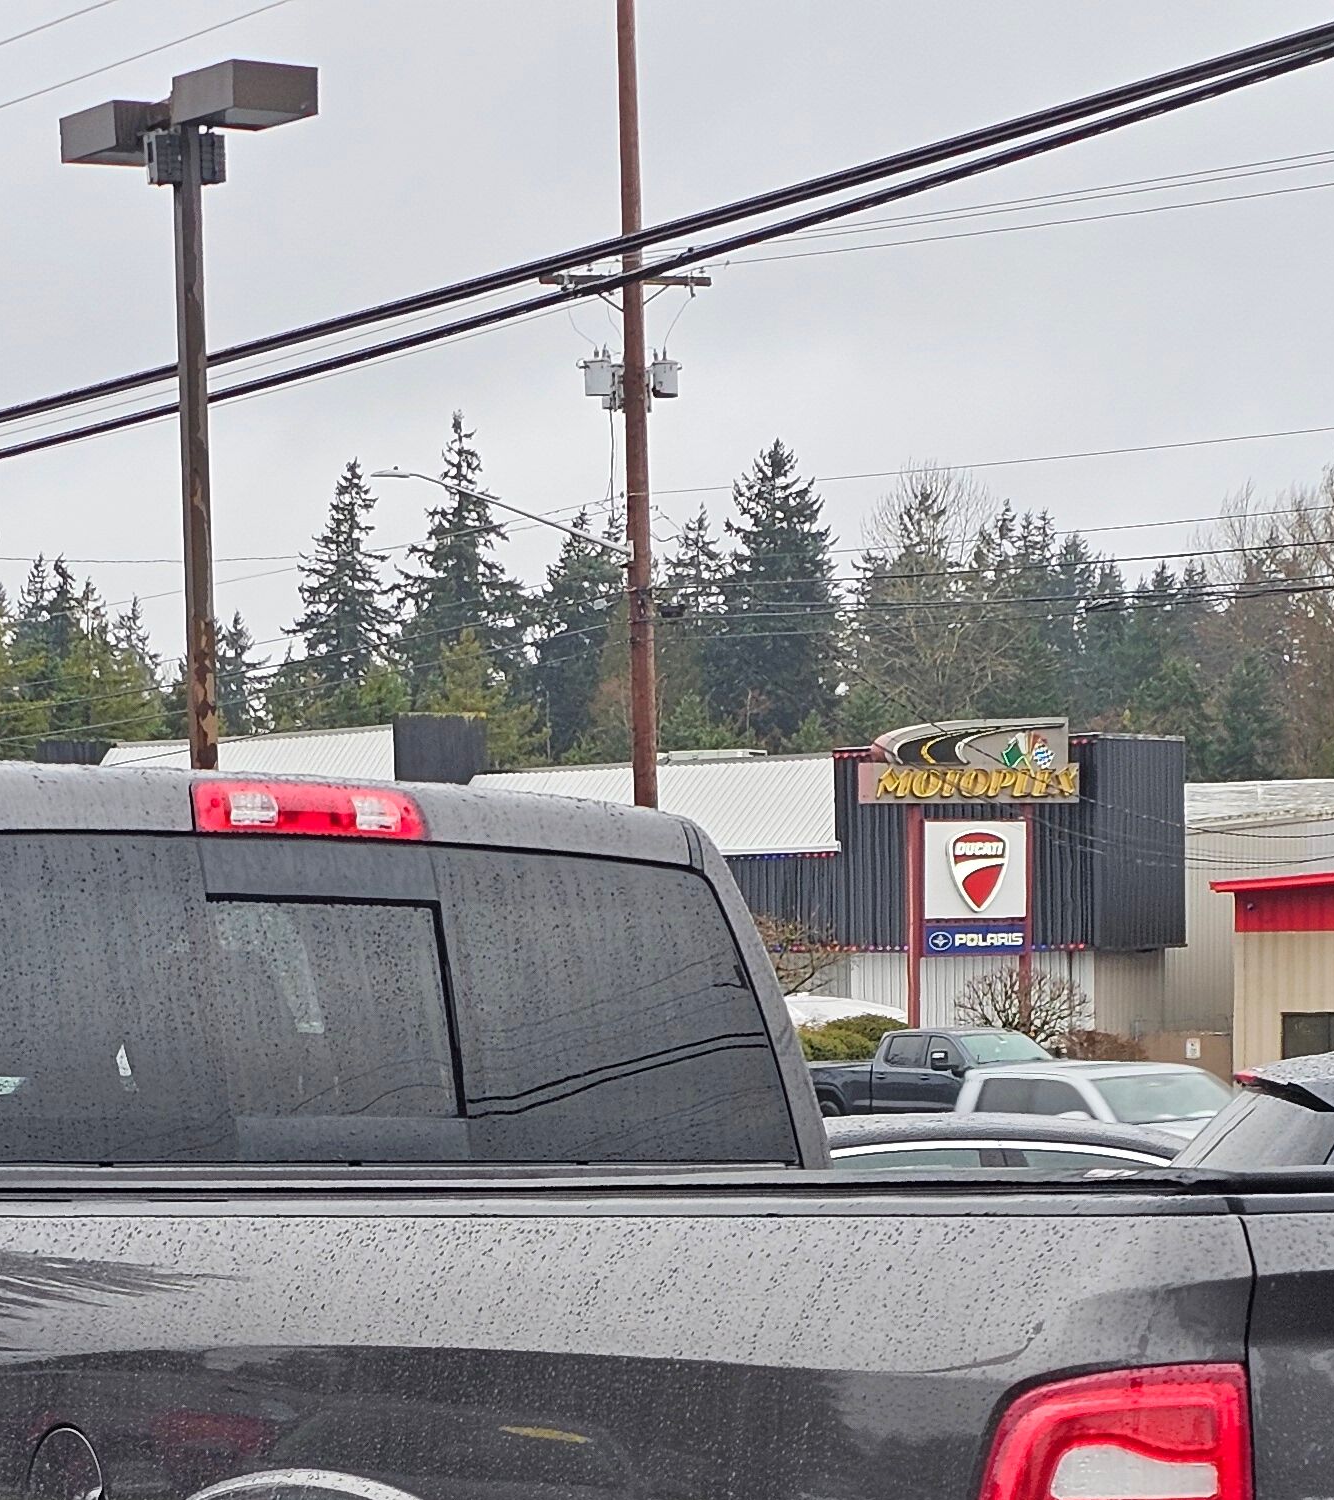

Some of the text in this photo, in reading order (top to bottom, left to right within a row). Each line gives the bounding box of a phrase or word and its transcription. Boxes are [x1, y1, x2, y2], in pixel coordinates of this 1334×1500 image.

[876, 767, 1080, 799] MOTOPLEX
[954, 841, 1005, 856] DUCATI
[954, 932, 1024, 947] POLARIS
